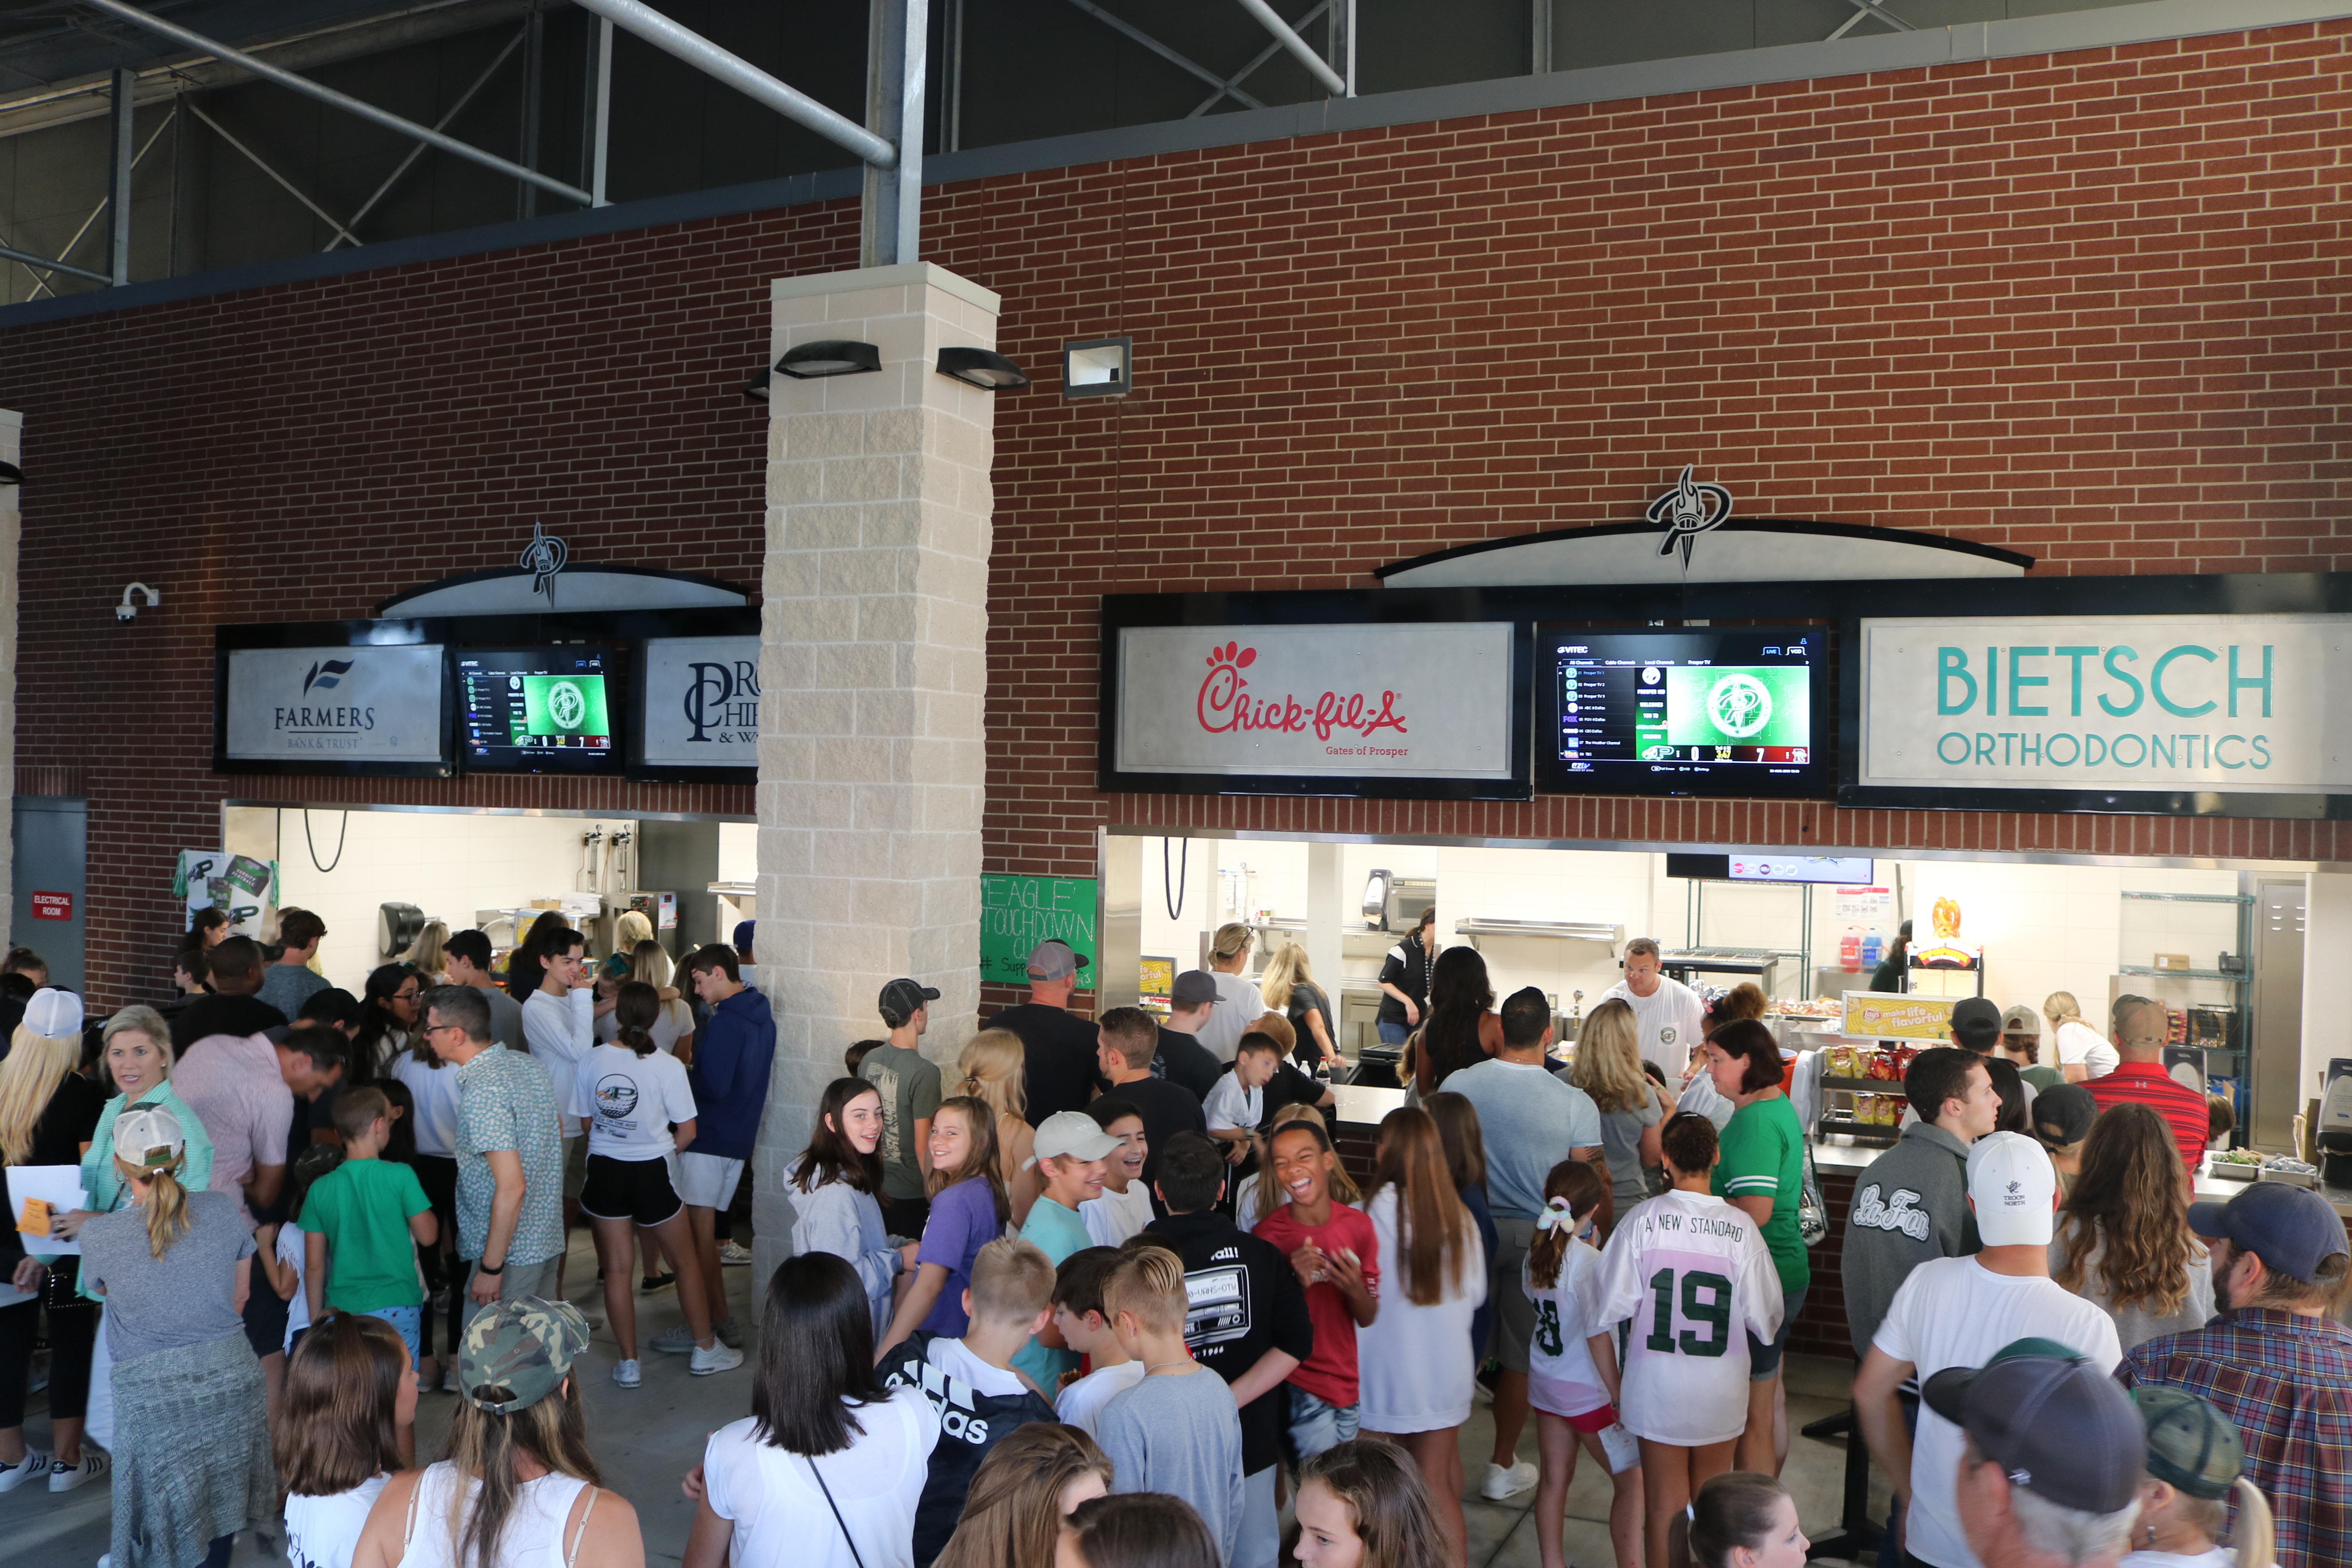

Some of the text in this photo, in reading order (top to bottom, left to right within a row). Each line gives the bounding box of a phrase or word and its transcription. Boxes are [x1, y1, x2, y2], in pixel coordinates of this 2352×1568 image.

[1937, 644, 2274, 718] BIETSCH
[1198, 664, 1407, 741] Chick-fil-A
[274, 707, 374, 730] FARMERS
[288, 737, 358, 749] BANK & TRUST
[719, 731, 758, 743] & W
[1326, 746, 1408, 758] Gates of Prosper
[1691, 746, 1699, 761] 0
[1756, 748, 1765, 762] 7
[1936, 731, 2272, 769] ORTHODONTICS
[232, 871, 254, 887] FOOTBALL
[236, 868, 256, 881] VARSITY
[34, 895, 70, 906] ELECTRICAL
[987, 879, 1074, 912] EAGLE
[43, 906, 61, 916] ROOM
[982, 906, 1094, 942] TOUCHDOWN
[1002, 957, 1026, 976] Supp
[1140, 965, 1149, 973] fe
[1140, 969, 1161, 980] orful
[1883, 1006, 1926, 1018] make life
[1891, 1012, 1944, 1028] flavorful
[1645, 1217, 1652, 1232] A
[1659, 1214, 1682, 1231] NEW
[1210, 1247, 1239, 1261] all!
[1188, 1283, 1237, 1299] 0-VANS-OTW
[1646, 1267, 1732, 1357] 19
[1184, 1322, 1195, 1334] NS
[1202, 1345, 1224, 1357] 1966
[884, 1372, 989, 1445] adas
